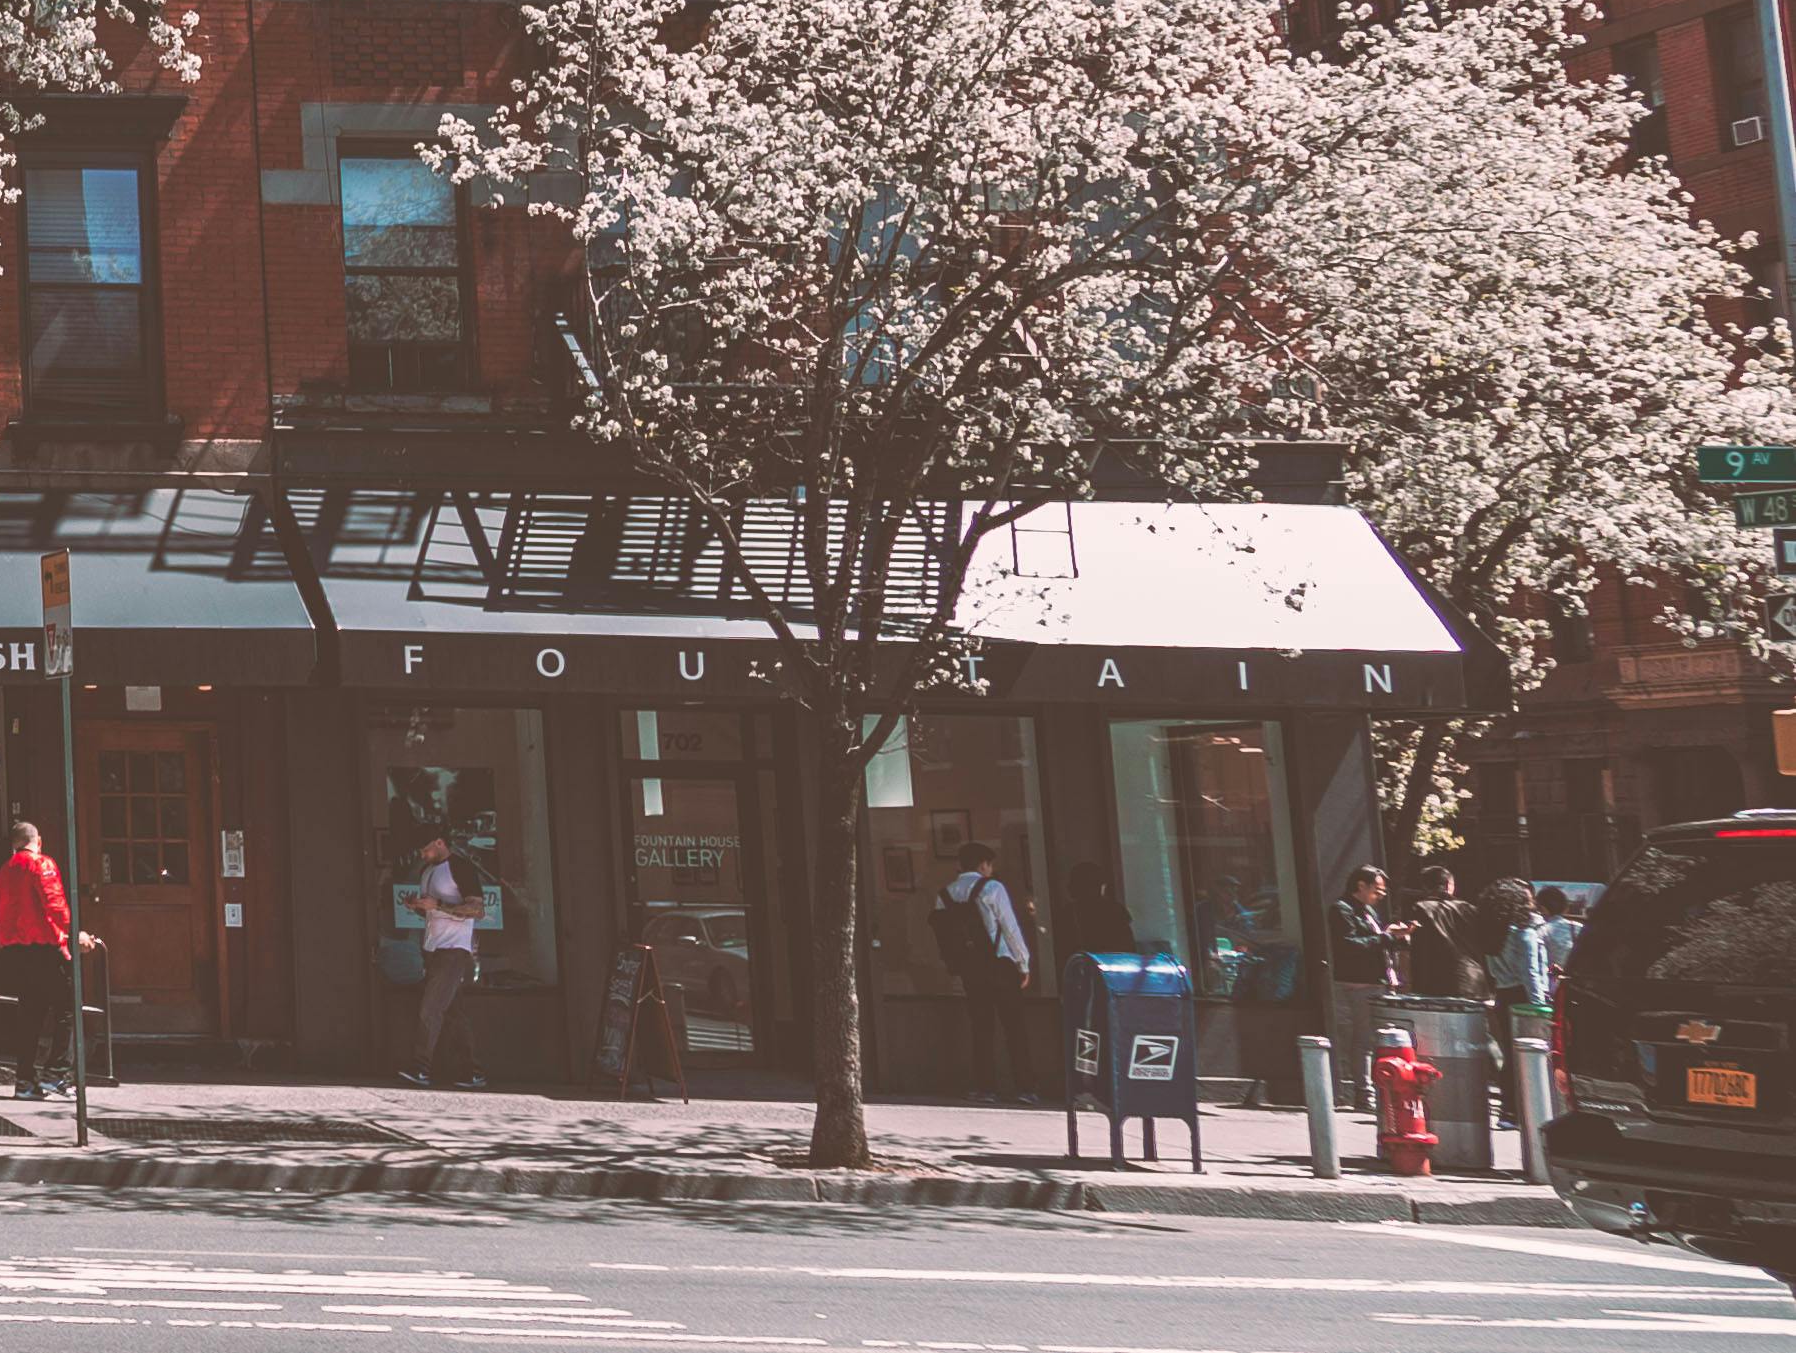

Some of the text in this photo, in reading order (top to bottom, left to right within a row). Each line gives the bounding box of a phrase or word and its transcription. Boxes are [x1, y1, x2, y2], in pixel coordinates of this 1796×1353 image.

[1725, 451, 1770, 477] 9 AV
[1740, 496, 1789, 524] W 48
[404, 645, 1393, 694] FOUTAIN
[663, 733, 703, 750] 702
[634, 835, 741, 848] FOUNTAIN HOUSE
[635, 848, 725, 868] GALLERY
